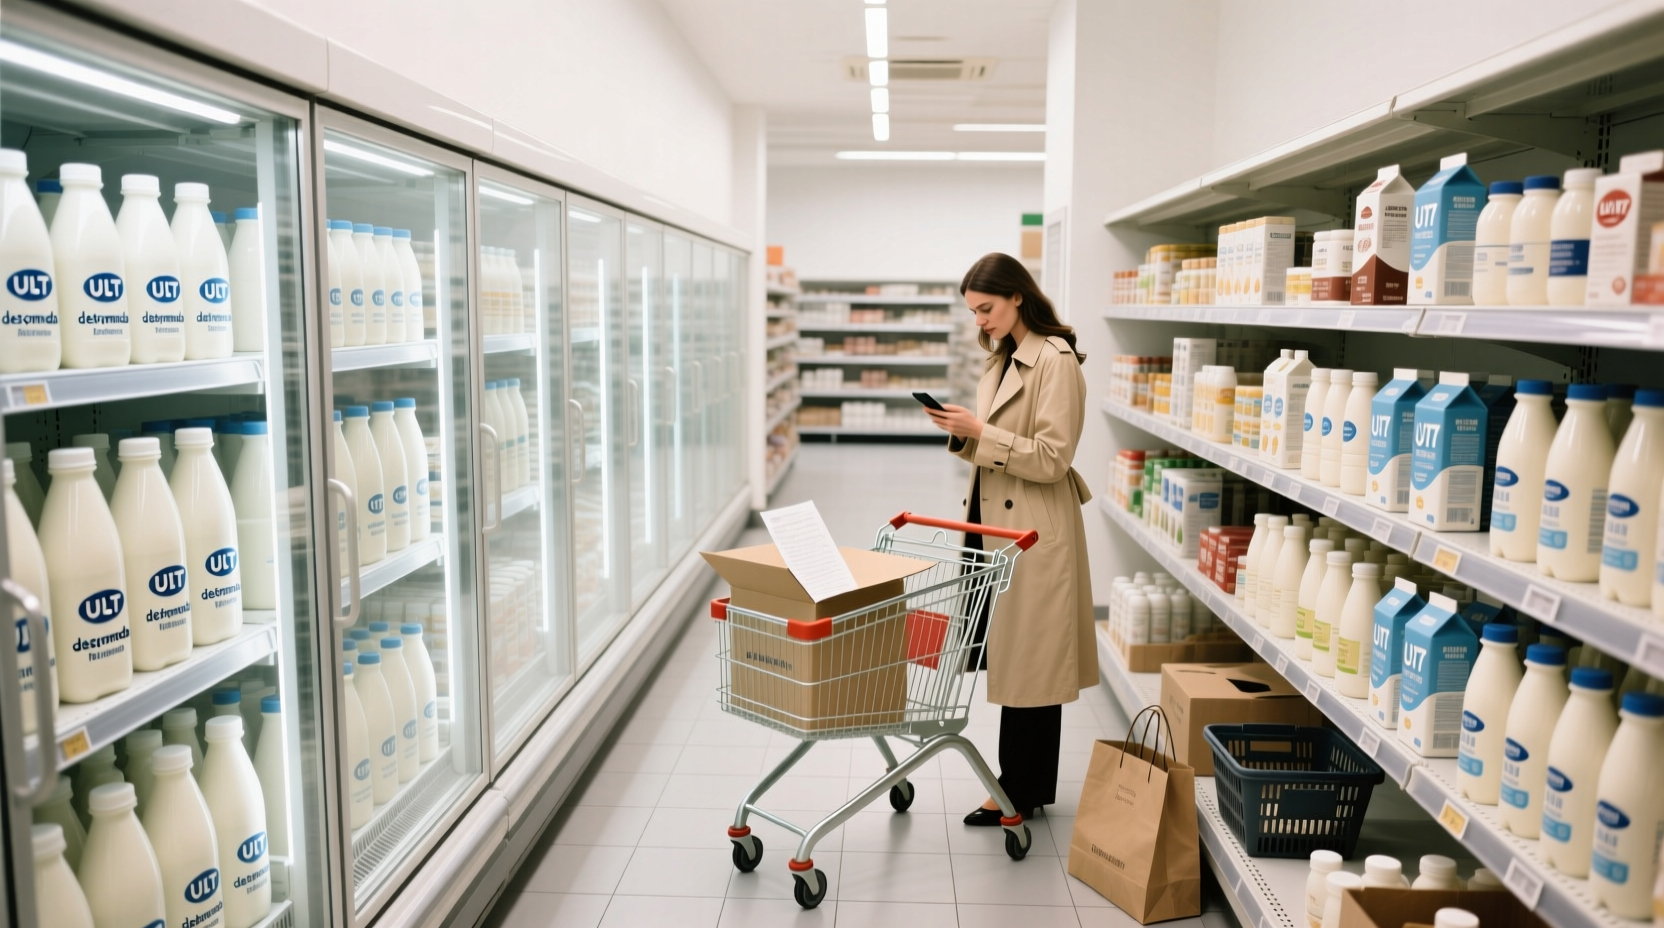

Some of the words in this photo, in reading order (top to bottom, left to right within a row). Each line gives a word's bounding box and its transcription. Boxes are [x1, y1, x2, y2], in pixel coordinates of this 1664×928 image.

[13, 275, 50, 296] ULT
[89, 279, 122, 298] ULT
[152, 281, 179, 299] ULT
[85, 593, 122, 619] ULT
[190, 871, 218, 900] ULT
